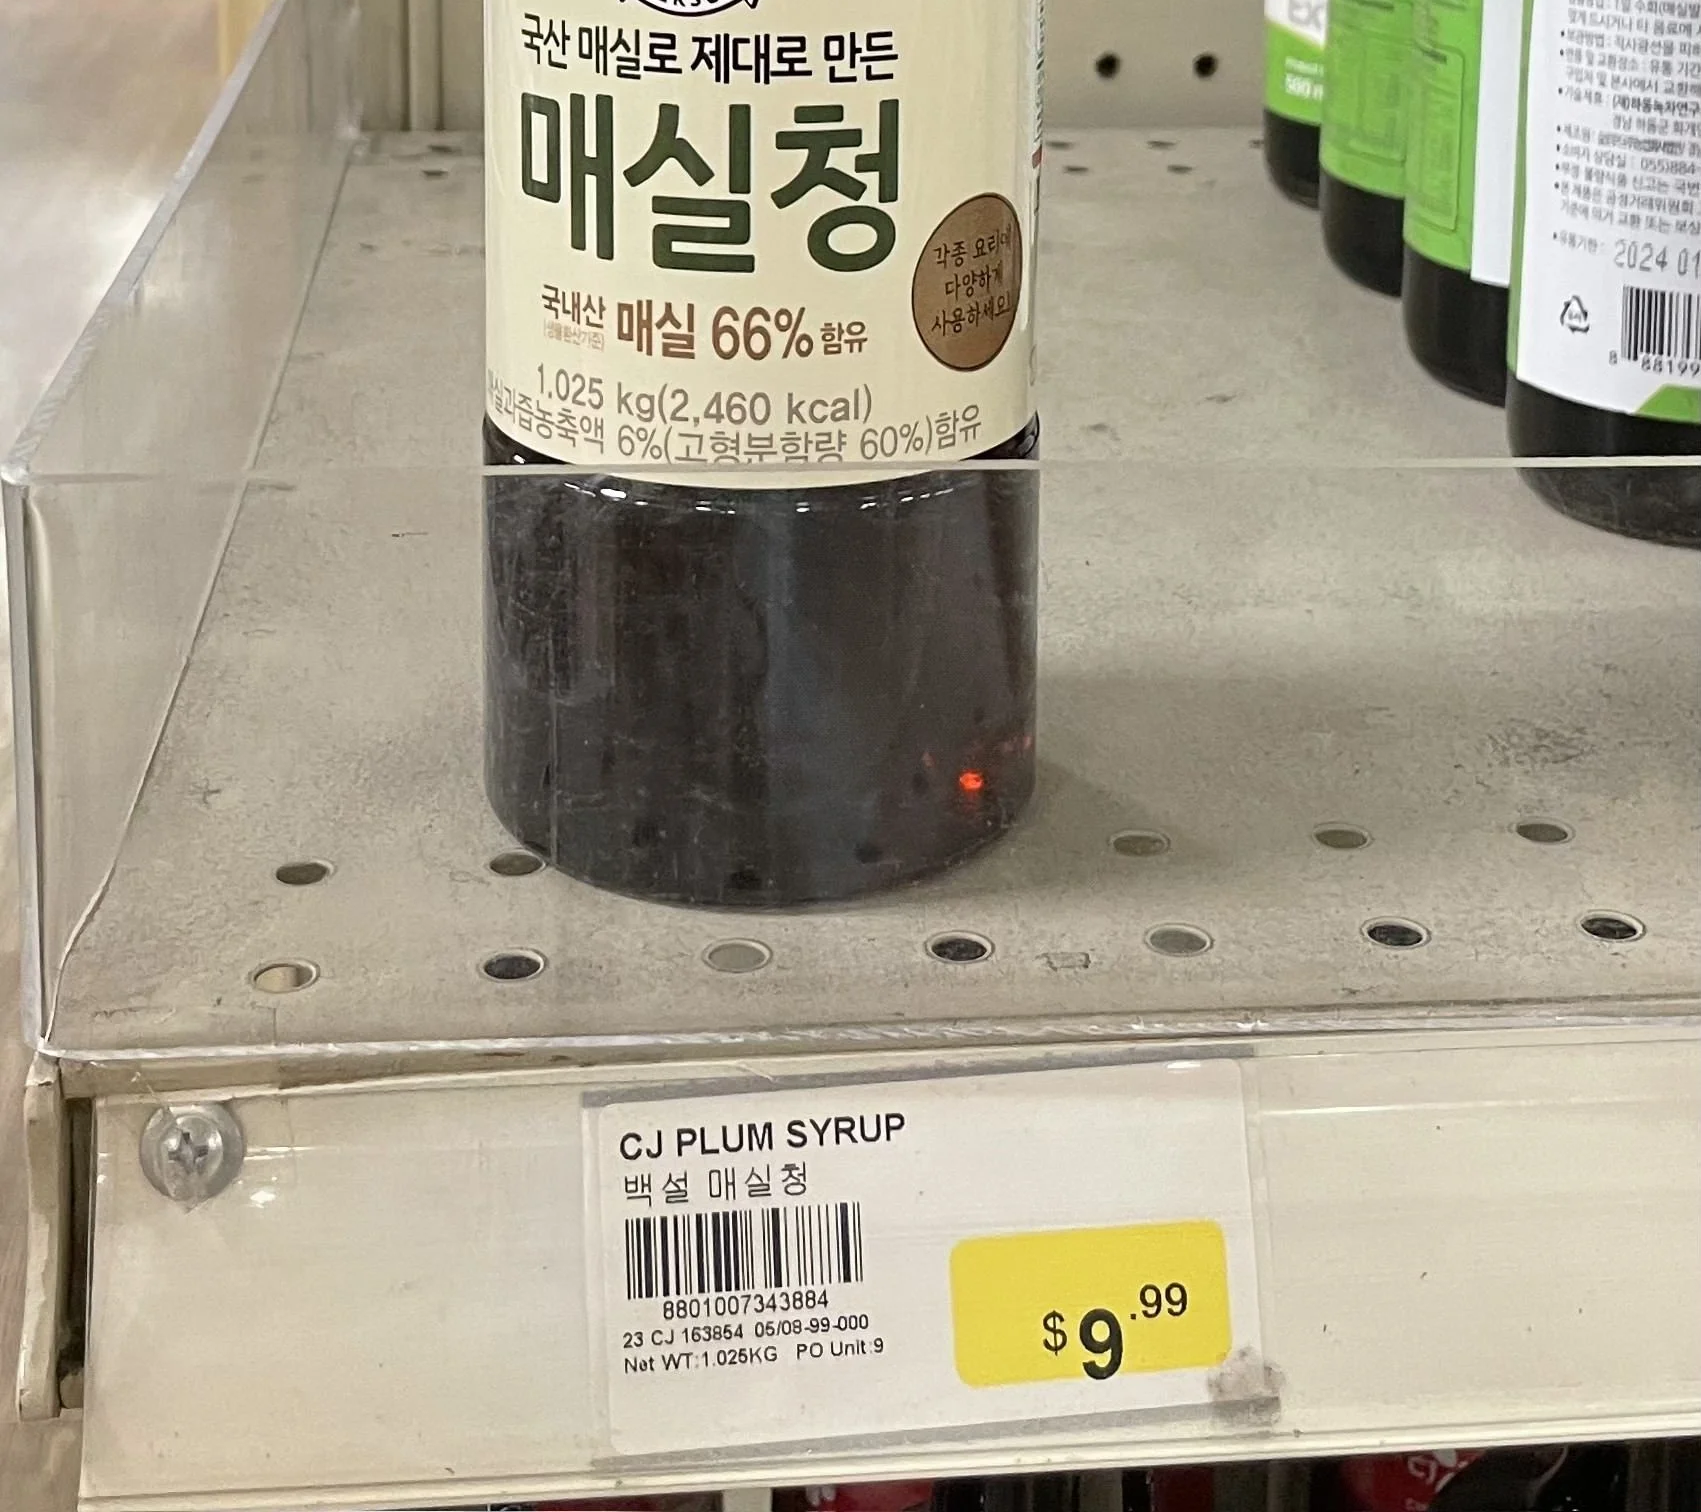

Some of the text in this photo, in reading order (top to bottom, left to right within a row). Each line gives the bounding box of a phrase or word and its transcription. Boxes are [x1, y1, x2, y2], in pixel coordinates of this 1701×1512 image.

[521, 13, 899, 85] 국산 매실로 제대로 만든
[521, 91, 899, 273] 매실청
[934, 241, 968, 269] 각종
[1614, 238, 1668, 272] 2024
[944, 260, 1003, 301] 다양하게
[541, 284, 868, 361] 국내산 매실 66% 함유
[537, 362, 872, 428] 1.025 kg(2,460 kcal)
[619, 1113, 906, 1160] CJ PLUM SYRUP
[624, 1162, 808, 1207] 백설 매실청
[663, 1289, 829, 1320] 8801007343884
[623, 1314, 869, 1348] 23 CJ 163854 05/08-99-000
[624, 1357, 655, 1374] Net
[796, 1343, 824, 1360] PO
